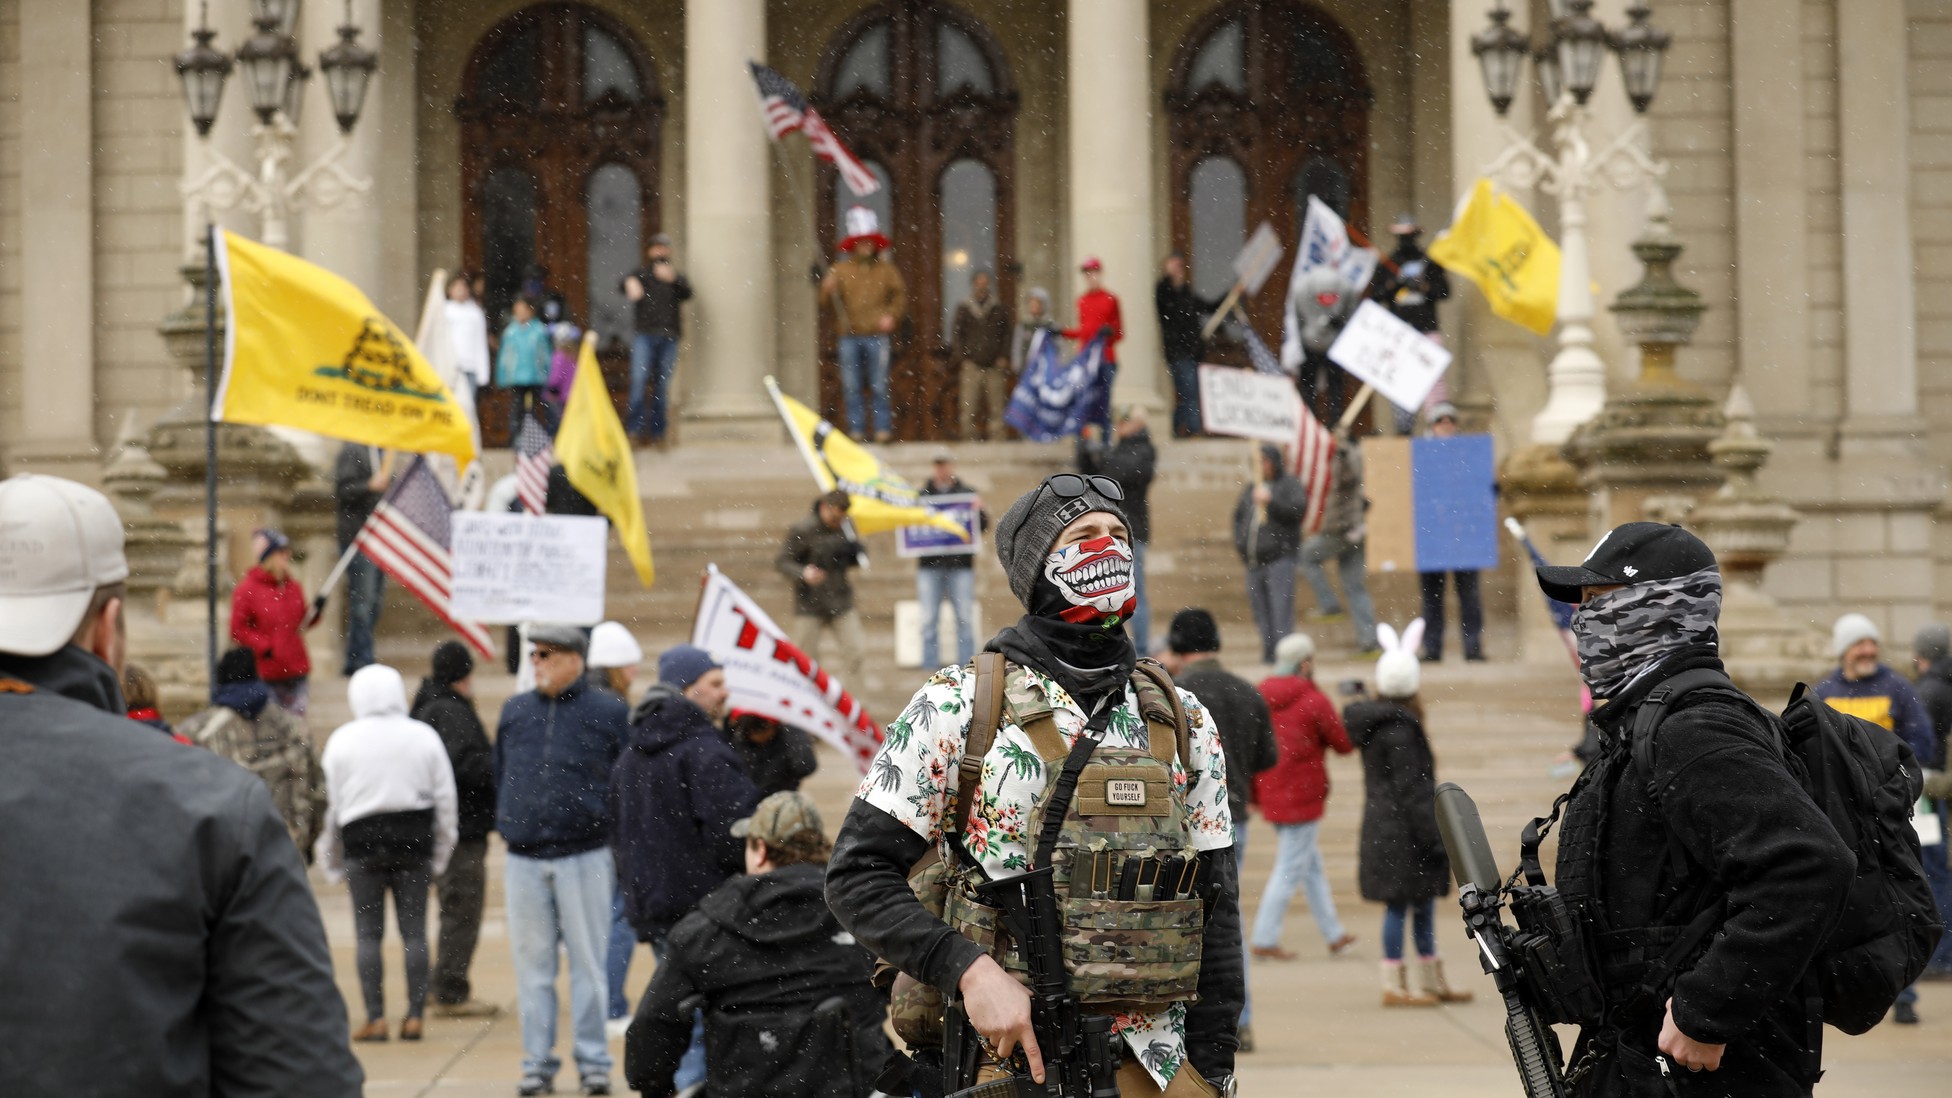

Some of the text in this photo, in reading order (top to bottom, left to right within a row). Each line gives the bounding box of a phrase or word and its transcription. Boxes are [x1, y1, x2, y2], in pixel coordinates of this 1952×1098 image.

[399, 405, 424, 419] ON
[431, 409, 454, 425] ME
[1114, 783, 1139, 791] GO FUCK
[1112, 793, 1140, 801] YOURSELF
